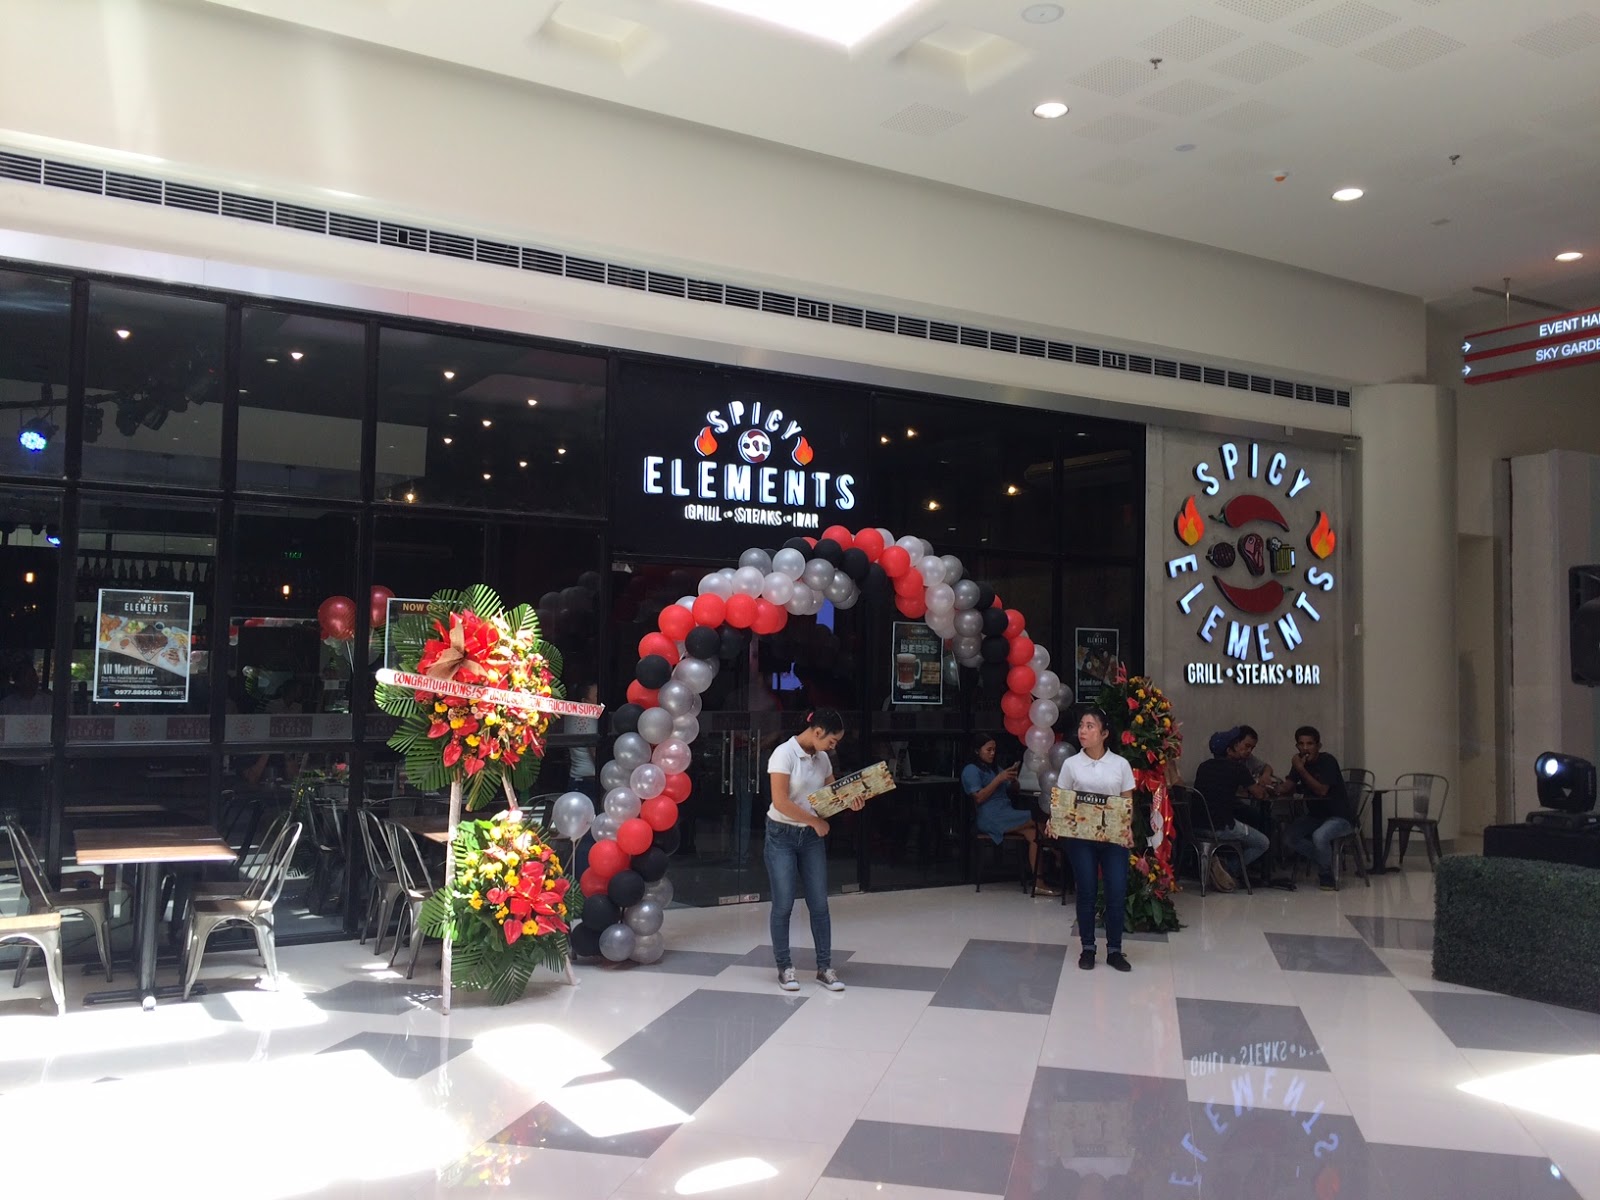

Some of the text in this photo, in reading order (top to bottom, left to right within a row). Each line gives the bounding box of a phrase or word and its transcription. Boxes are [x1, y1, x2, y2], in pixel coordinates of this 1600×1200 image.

[1539, 317, 1580, 336] EVENT
[1535, 346, 1560, 362] SKY
[706, 400, 802, 440] SPICY
[1194, 442, 1311, 498] SPICY
[643, 455, 855, 510] ELEMENTS
[684, 504, 722, 522] GRILL
[733, 507, 783, 527] STEAKS
[124, 602, 169, 613] ELEMENTS
[402, 602, 425, 612] NOW
[1166, 554, 1335, 662] ELEMENTS
[900, 644, 938, 655] BEERS
[102, 663, 113, 675] All
[114, 663, 133, 675] Meat
[1186, 663, 1321, 685] GRILL STEAKS BAR
